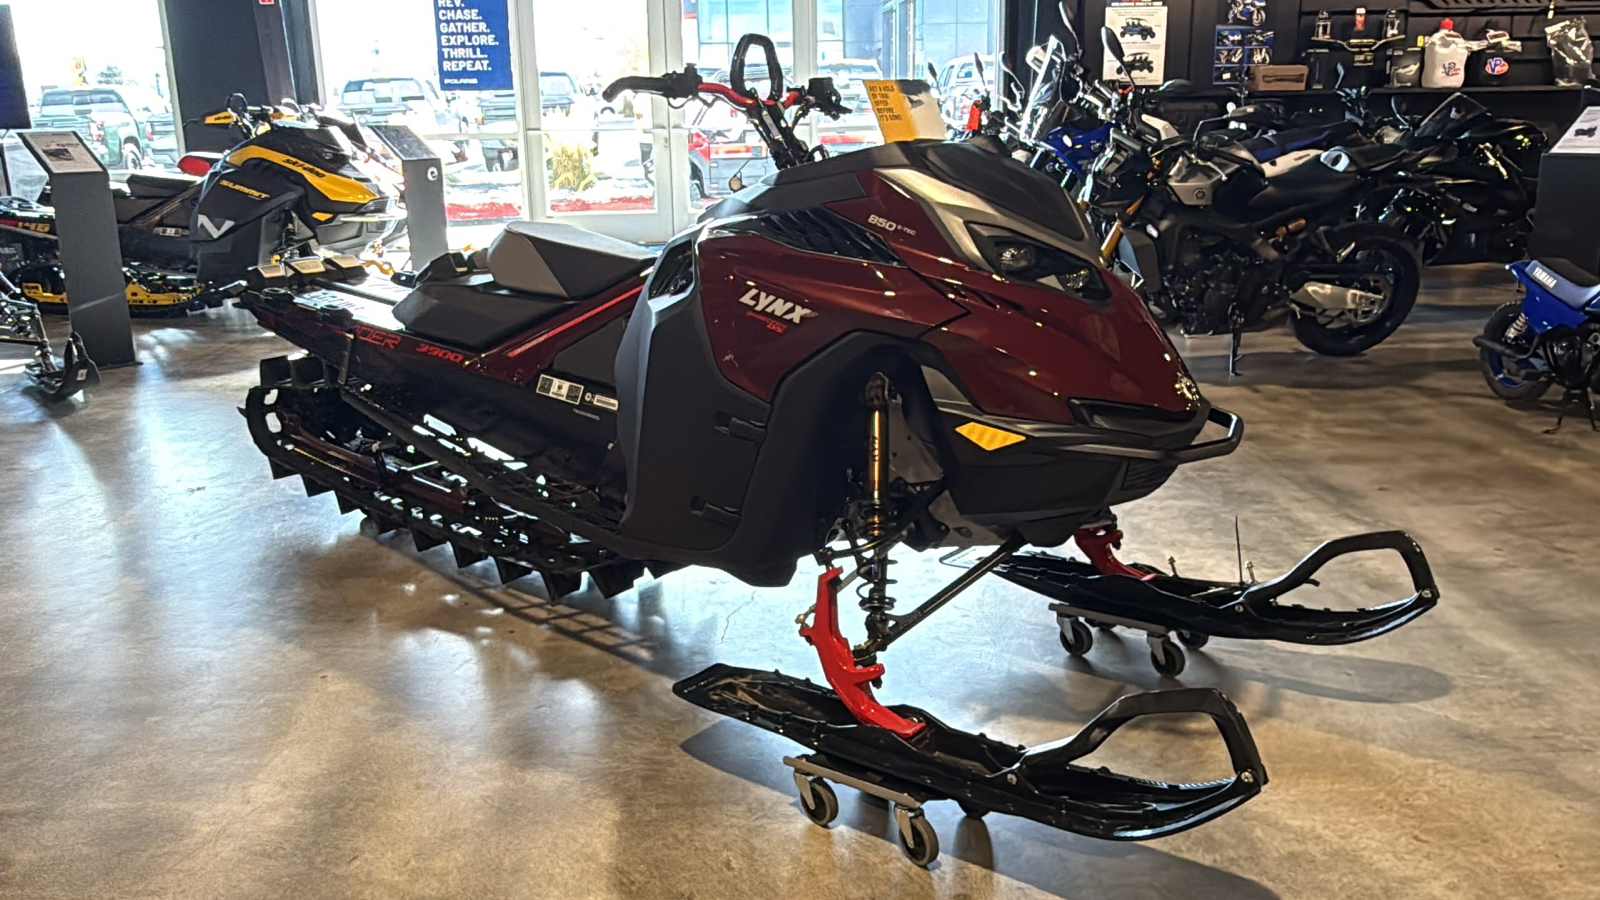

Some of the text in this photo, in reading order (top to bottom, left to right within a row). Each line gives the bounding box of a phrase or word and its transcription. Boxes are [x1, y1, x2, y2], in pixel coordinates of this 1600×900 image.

[437, 0, 465, 8] REV.
[438, 9, 483, 20] CHASE.
[440, 22, 490, 33] GATHER.
[441, 34, 499, 46] EXPLORE.
[442, 47, 488, 58] THRILL.
[443, 60, 492, 71] REPEAT.
[220, 179, 271, 199] SUMMIT
[868, 214, 897, 231] 850
[1532, 266, 1558, 289] YAMAHA
[738, 288, 813, 325] LYNX
[416, 343, 464, 363] 3900
